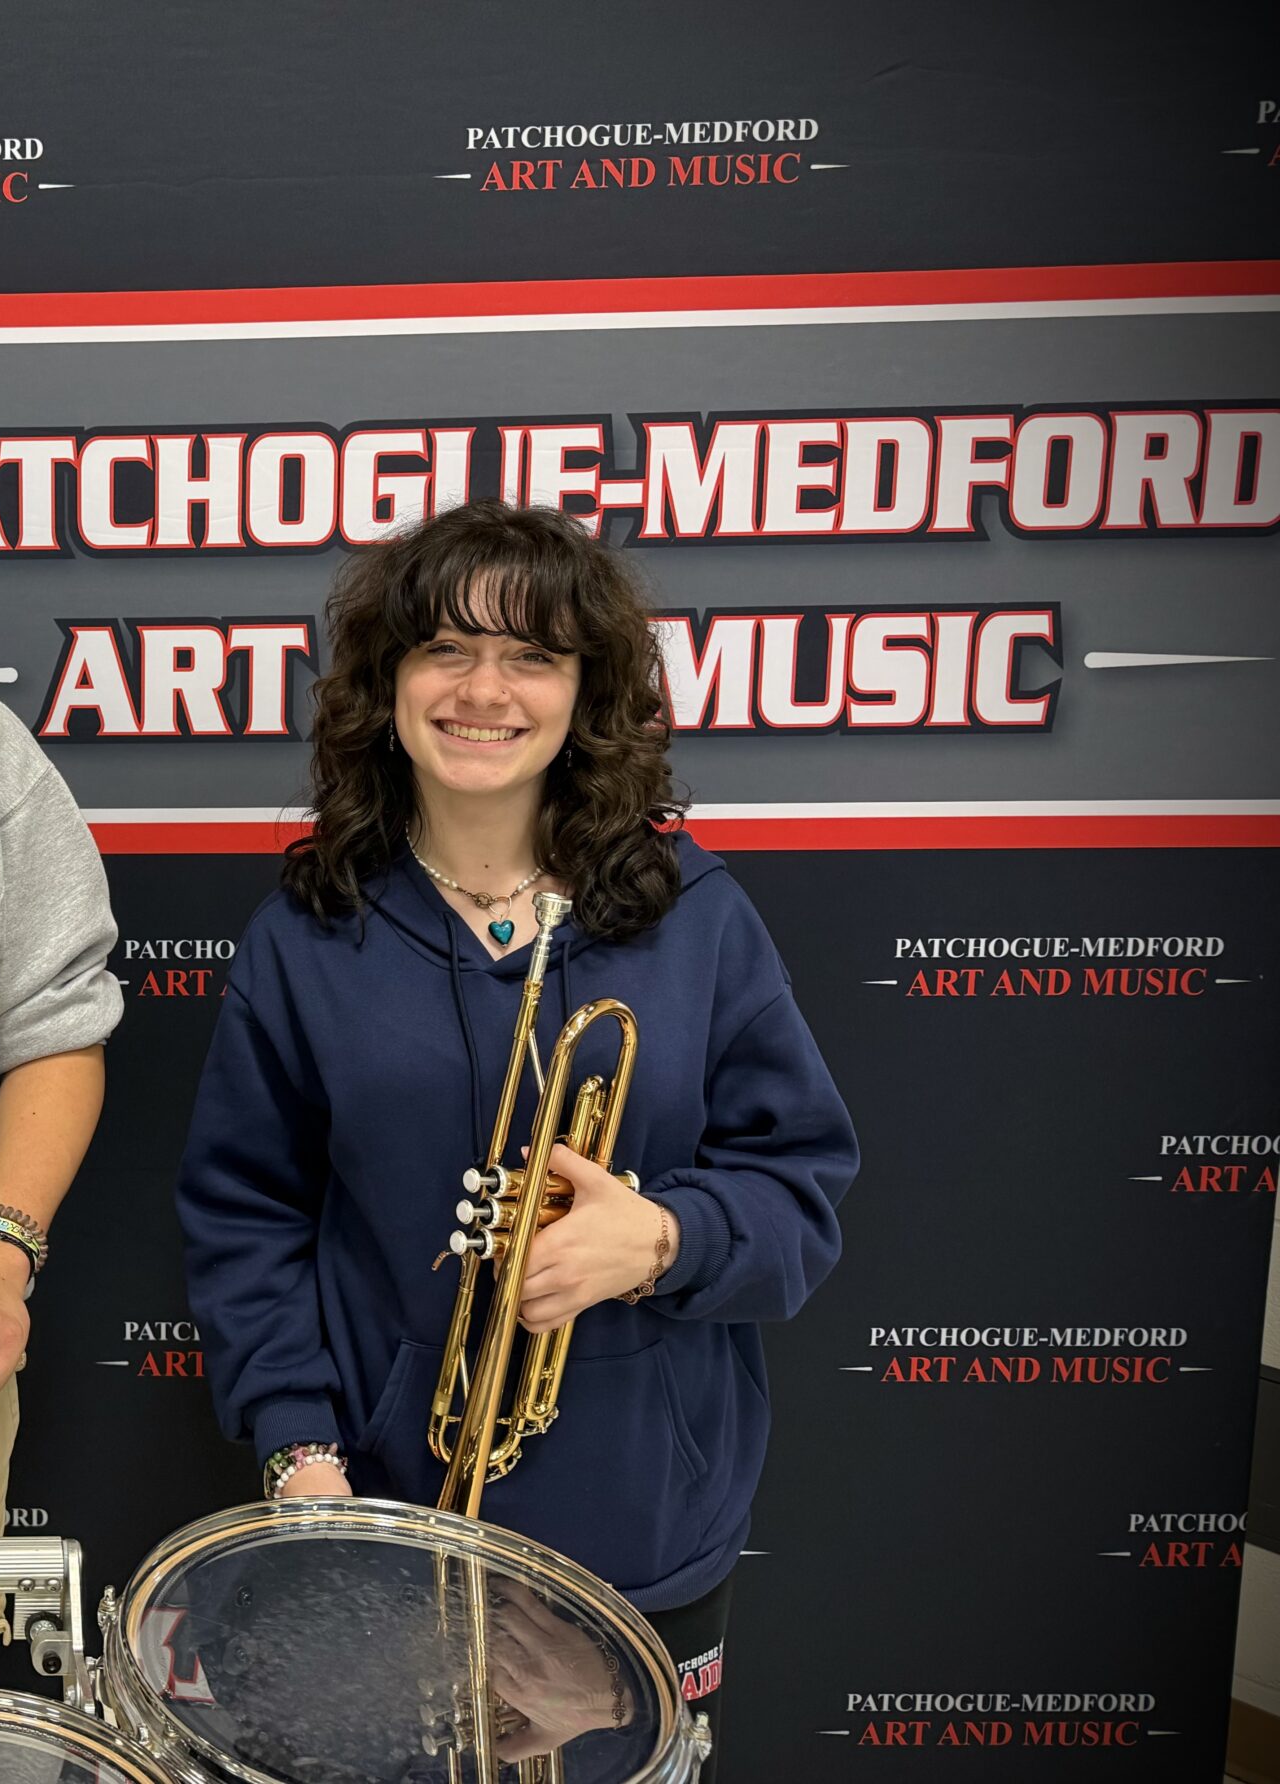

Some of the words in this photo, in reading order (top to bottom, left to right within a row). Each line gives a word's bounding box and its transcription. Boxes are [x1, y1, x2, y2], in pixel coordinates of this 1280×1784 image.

[466, 118, 819, 150] PATCHOGUE-MEDFORD
[480, 159, 563, 192] ART
[571, 156, 656, 190] AND
[668, 152, 802, 188] MUSIC
[39, 622, 310, 738] ART
[644, 609, 1054, 731] MUSIC
[895, 936, 1224, 959] PATCHOGUE-MEDFORD
[138, 969, 213, 997] ART
[906, 968, 984, 997] ART
[990, 968, 1072, 997] AND
[1082, 967, 1207, 997] MUSIC
[1170, 1165, 1248, 1193] ART
[869, 1327, 1187, 1347] PATCHOGUE-MEDFORD
[881, 1356, 957, 1383] ART
[963, 1356, 1041, 1384] AND
[1052, 1356, 1171, 1384] MUSIC
[1138, 1541, 1214, 1568] ART
[846, 1693, 1155, 1713] PATCHOGUE-MEDFORD
[858, 1721, 931, 1746] ART
[937, 1721, 1013, 1746] AND
[1023, 1721, 1139, 1747] MUSIC
